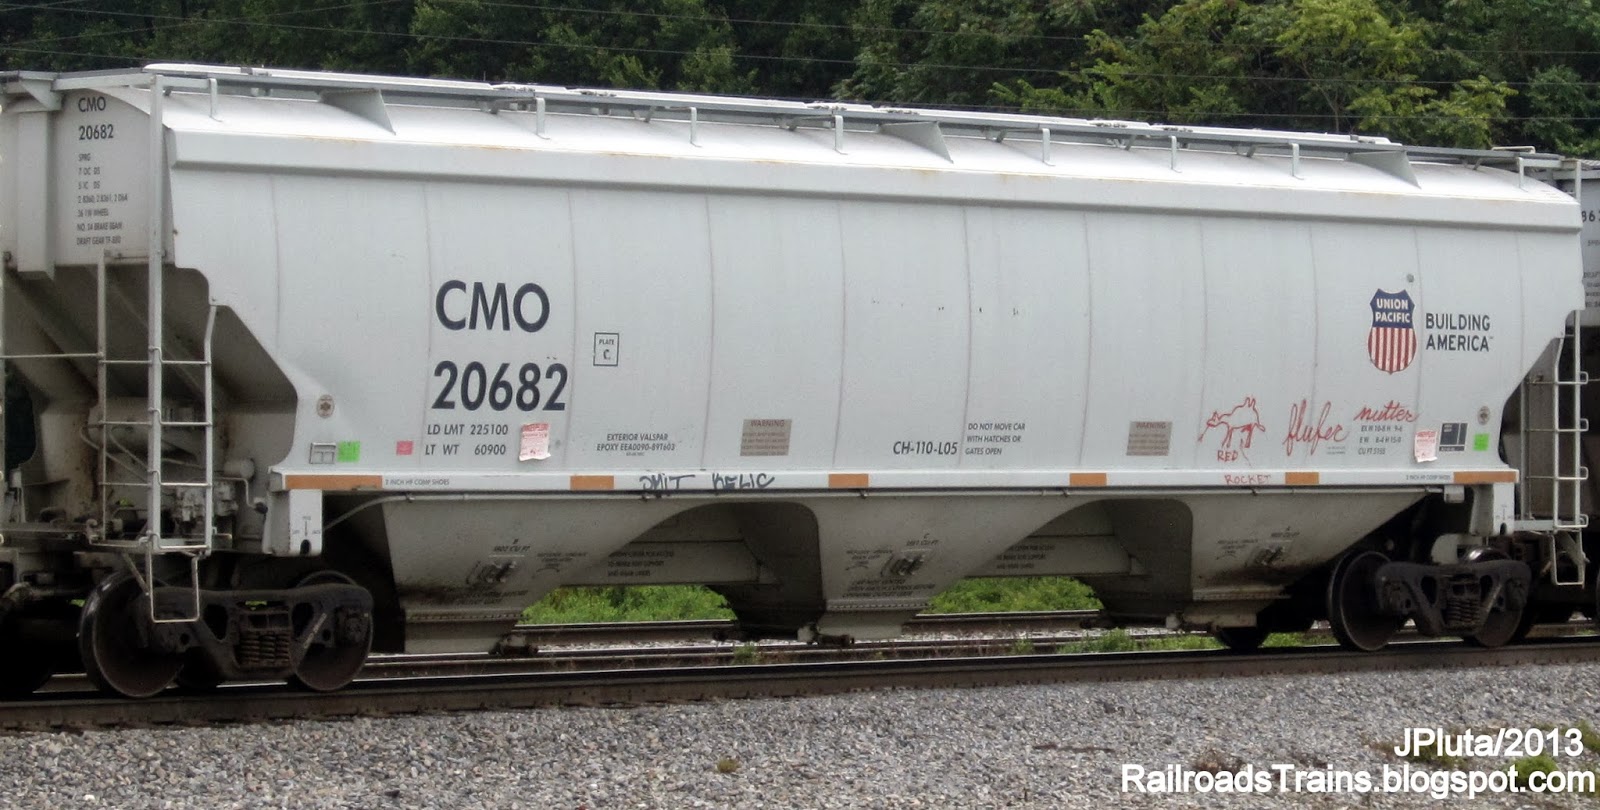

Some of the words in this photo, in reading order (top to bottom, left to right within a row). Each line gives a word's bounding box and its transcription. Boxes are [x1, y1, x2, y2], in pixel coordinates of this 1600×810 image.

[78, 97, 106, 113] CMO
[79, 124, 114, 140] 20682
[435, 279, 550, 333] CMO
[1376, 298, 1409, 310] UNION
[1375, 311, 1411, 323] PACIFIC
[1425, 313, 1491, 331] BUILDING
[1425, 334, 1490, 352] AMERICA
[431, 360, 568, 412] 20682
[750, 419, 785, 427] WARNING
[427, 424, 441, 435] LD
[444, 424, 465, 435] LMT
[470, 424, 508, 435] 225100
[607, 433, 638, 441] EXTERIOR
[640, 433, 669, 441] VALSPAR
[966, 435, 983, 443] WITH
[984, 435, 1011, 443] HATCHES
[1012, 435, 1022, 443] OR
[425, 444, 436, 456] LT
[443, 444, 459, 456] WT
[474, 444, 507, 456] 60900
[596, 443, 619, 451] EPOXY
[893, 441, 958, 455] CH-110-L05
[965, 447, 984, 455] GATES
[985, 447, 1002, 455] OPEN
[1217, 450, 1239, 462] RED
[1224, 474, 1271, 485] ROCKET
